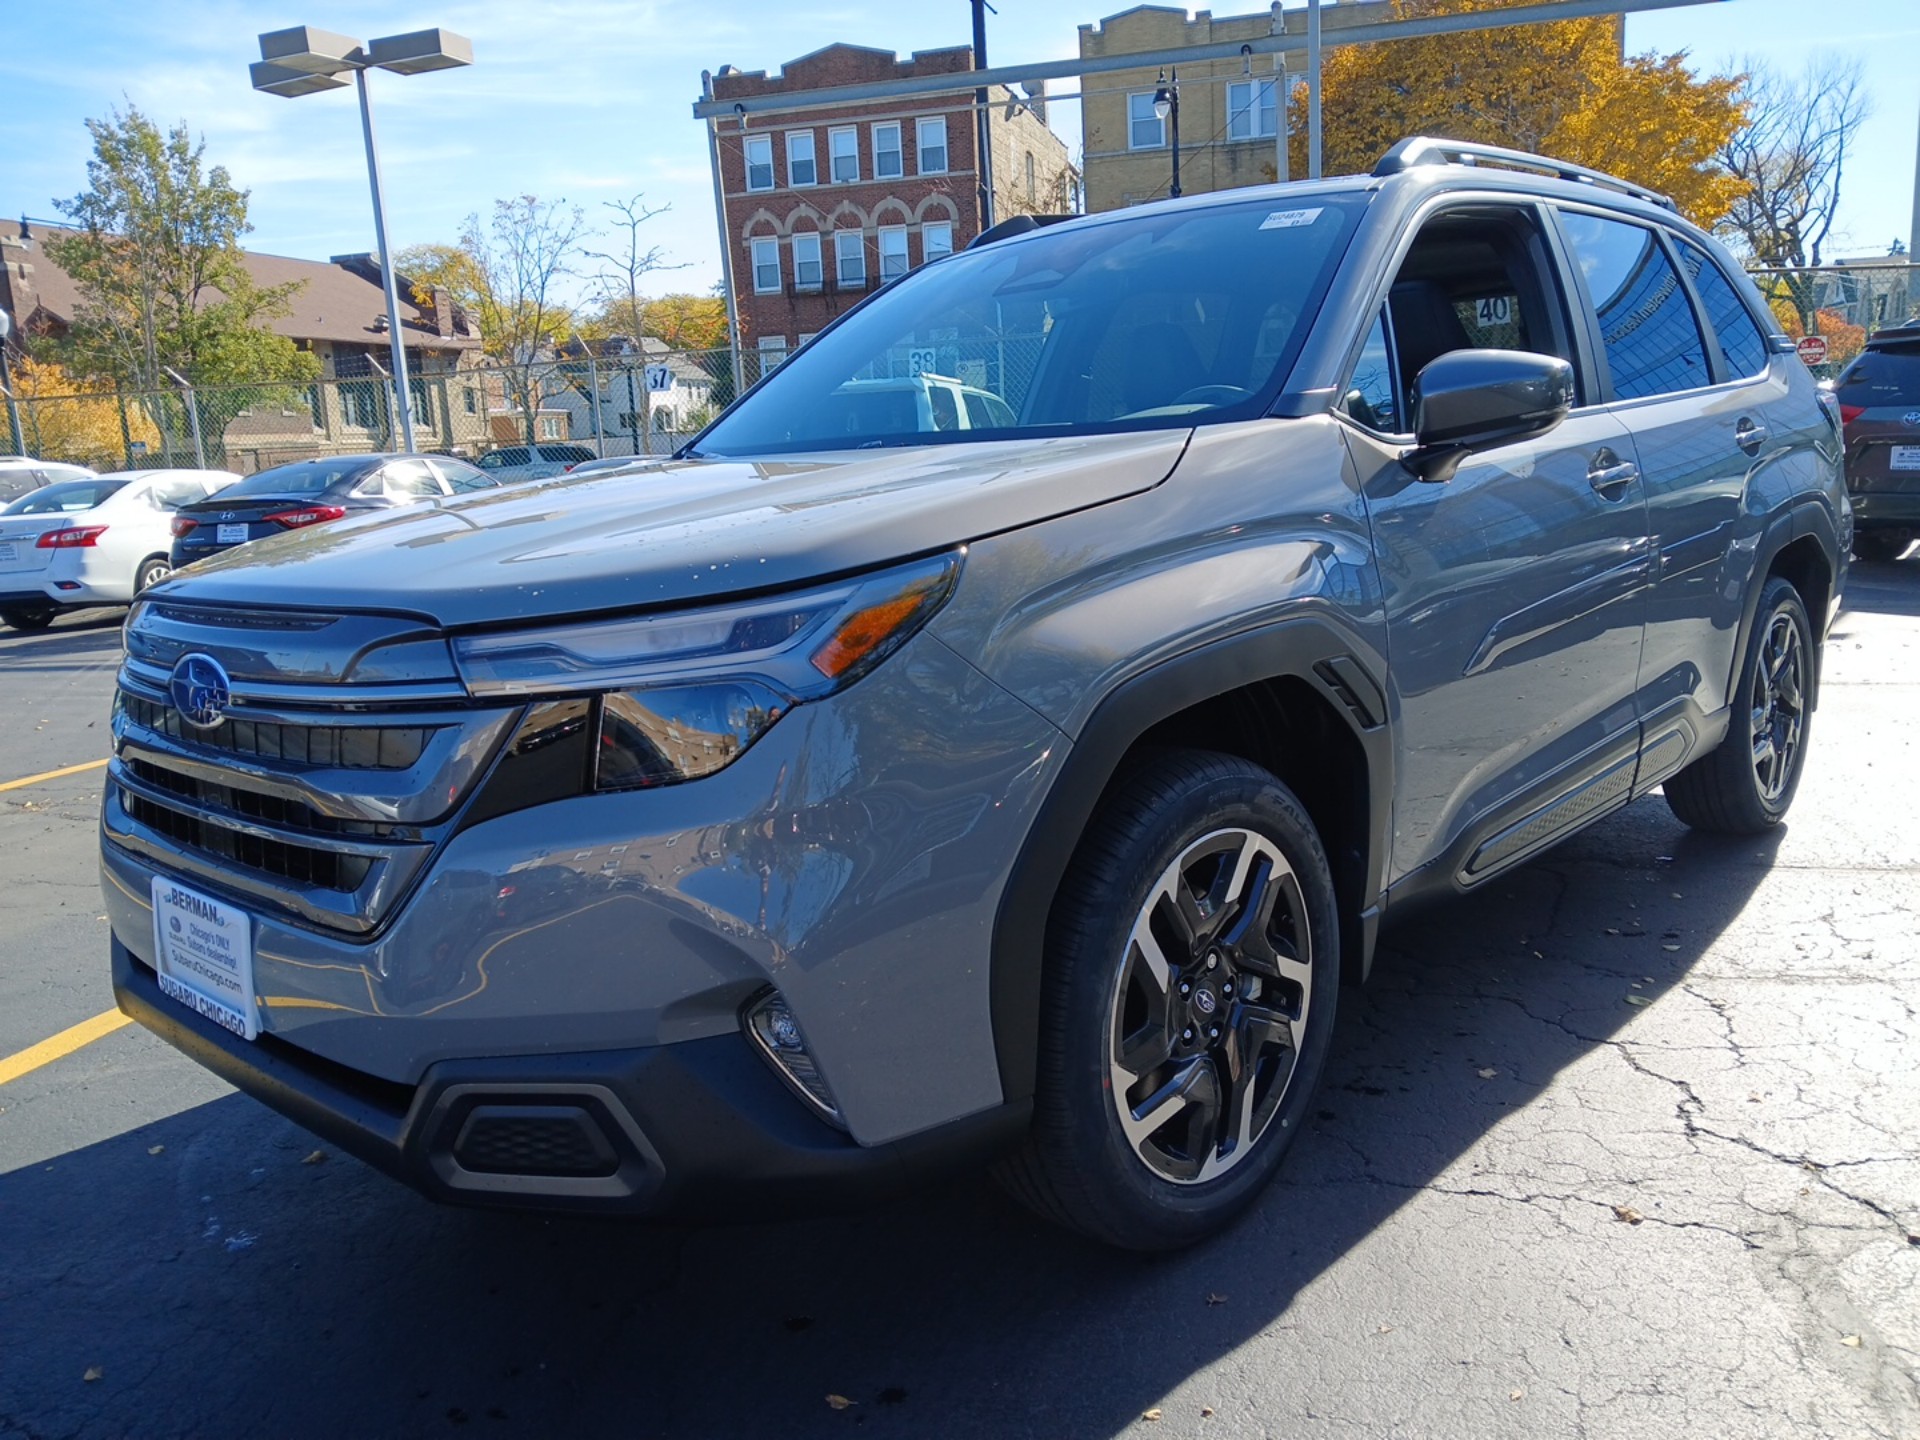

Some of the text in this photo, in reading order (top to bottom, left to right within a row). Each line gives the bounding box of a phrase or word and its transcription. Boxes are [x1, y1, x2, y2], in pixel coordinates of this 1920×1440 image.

[1479, 297, 1508, 322] 40
[911, 350, 934, 374] 38
[646, 367, 668, 389] 37
[1271, 794, 1328, 875] FALKEN
[171, 887, 218, 923] BERMAN
[187, 936, 206, 955] Subaru
[189, 922, 230, 949] Chicago's ONLY
[171, 949, 243, 994] SubaruChicago.com
[159, 974, 246, 1038] SUBARU CHICAGO
